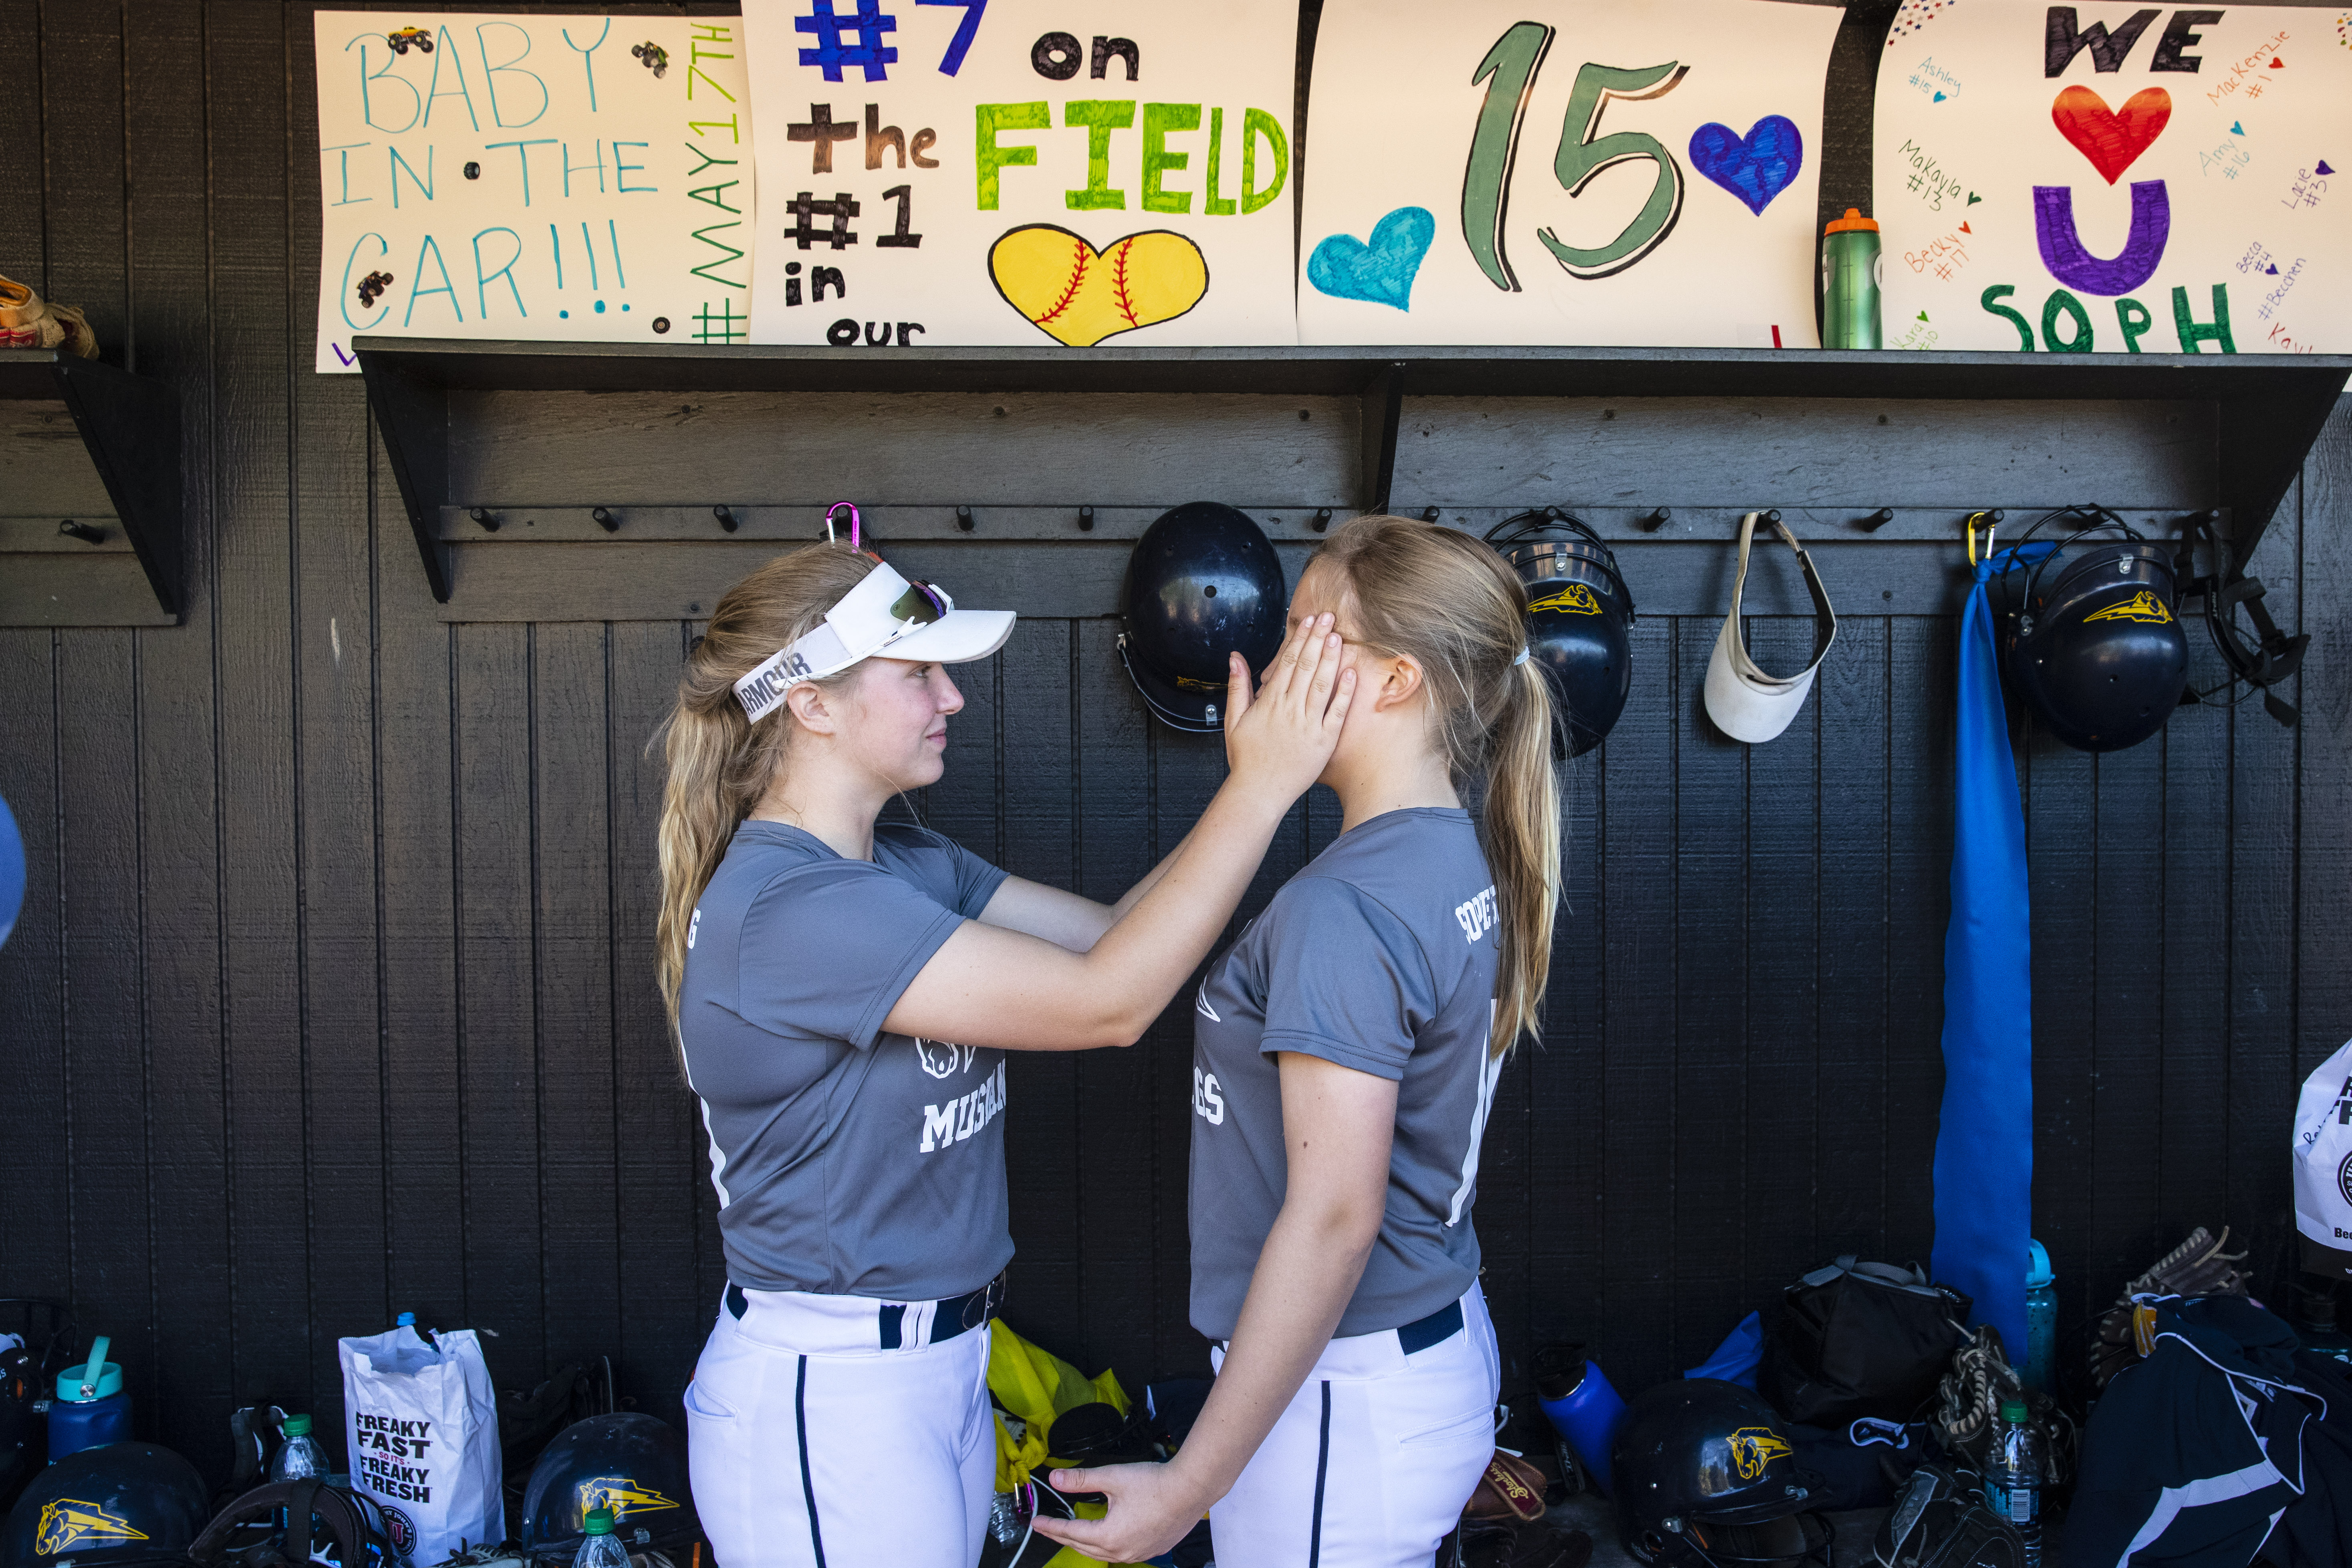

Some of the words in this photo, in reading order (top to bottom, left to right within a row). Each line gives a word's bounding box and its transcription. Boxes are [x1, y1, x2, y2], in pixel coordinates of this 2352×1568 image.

[794, 0, 988, 83] #7
[1030, 30, 1140, 82] on
[2044, 6, 2226, 79] WE
[345, 17, 611, 133] BABY
[1909, 74, 1932, 94] #15
[1918, 56, 1961, 98] Ashley
[2245, 75, 2272, 99] #1
[322, 142, 434, 208] IN
[486, 139, 658, 207] THE
[786, 102, 940, 175] the
[975, 100, 1289, 216] FIELD
[1461, 20, 1691, 292] 15
[2199, 138, 2239, 177] Amy
[2222, 151, 2250, 180] #16
[1907, 174, 1942, 211] #13
[2281, 168, 2312, 210] Lacie
[2303, 179, 2327, 208] #3
[784, 184, 923, 251] #1
[2032, 179, 2171, 296] U
[341, 219, 632, 330] CAR!!!
[1933, 249, 1969, 282] #17
[2236, 241, 2263, 274] Becca
[2254, 251, 2272, 272] #4
[786, 261, 846, 307] in
[826, 318, 926, 346] our
[1889, 323, 1924, 350] Kara
[1981, 283, 2237, 353] SOPH
[356, 1411, 431, 1438] FREAKY
[357, 1428, 431, 1459] FAST
[379, 1451, 389, 1460] SO
[391, 1455, 405, 1465] IT'S
[359, 1453, 430, 1484] FREAKY
[362, 1471, 430, 1504] FRESH
